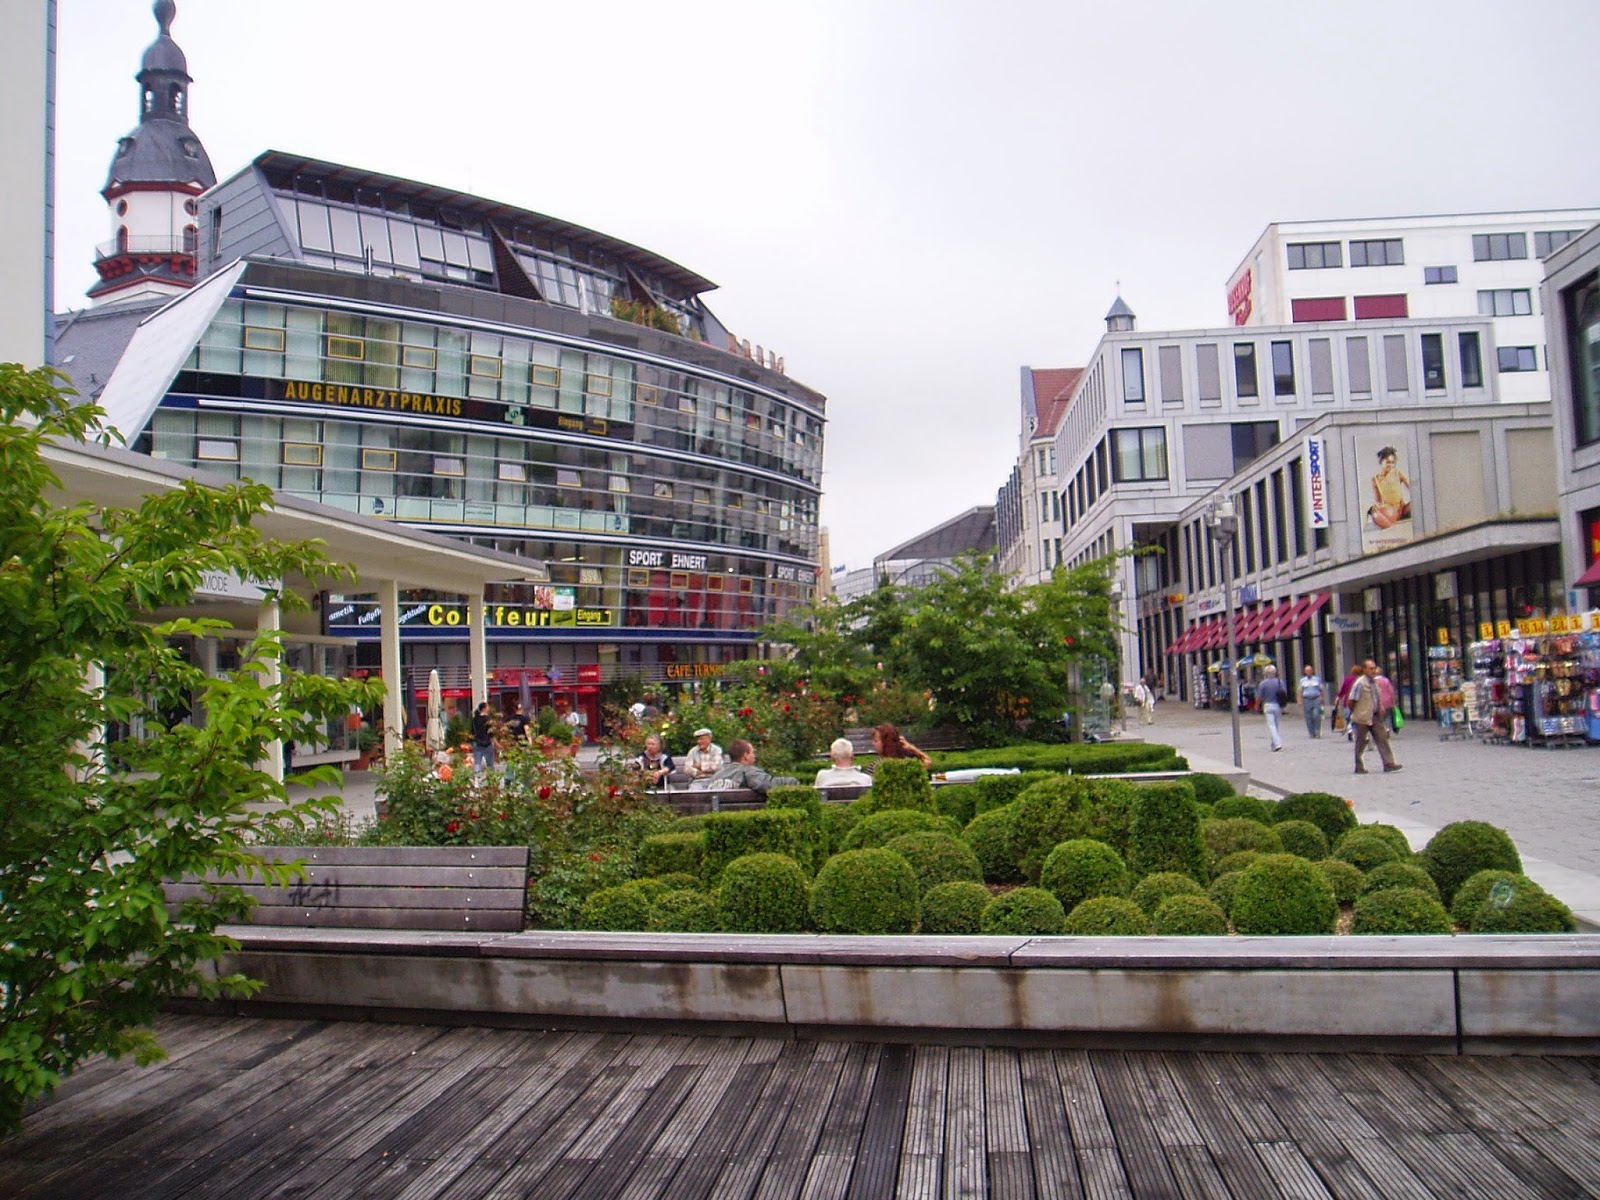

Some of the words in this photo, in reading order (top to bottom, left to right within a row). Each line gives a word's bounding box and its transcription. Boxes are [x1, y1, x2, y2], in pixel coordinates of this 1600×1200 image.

[285, 381, 462, 416] AUGENARZTPRAXIS
[1308, 438, 1323, 510] INTERSPORT
[629, 550, 662, 566] SPORT
[671, 554, 707, 569] EHNERT
[577, 610, 600, 623] Eingang
